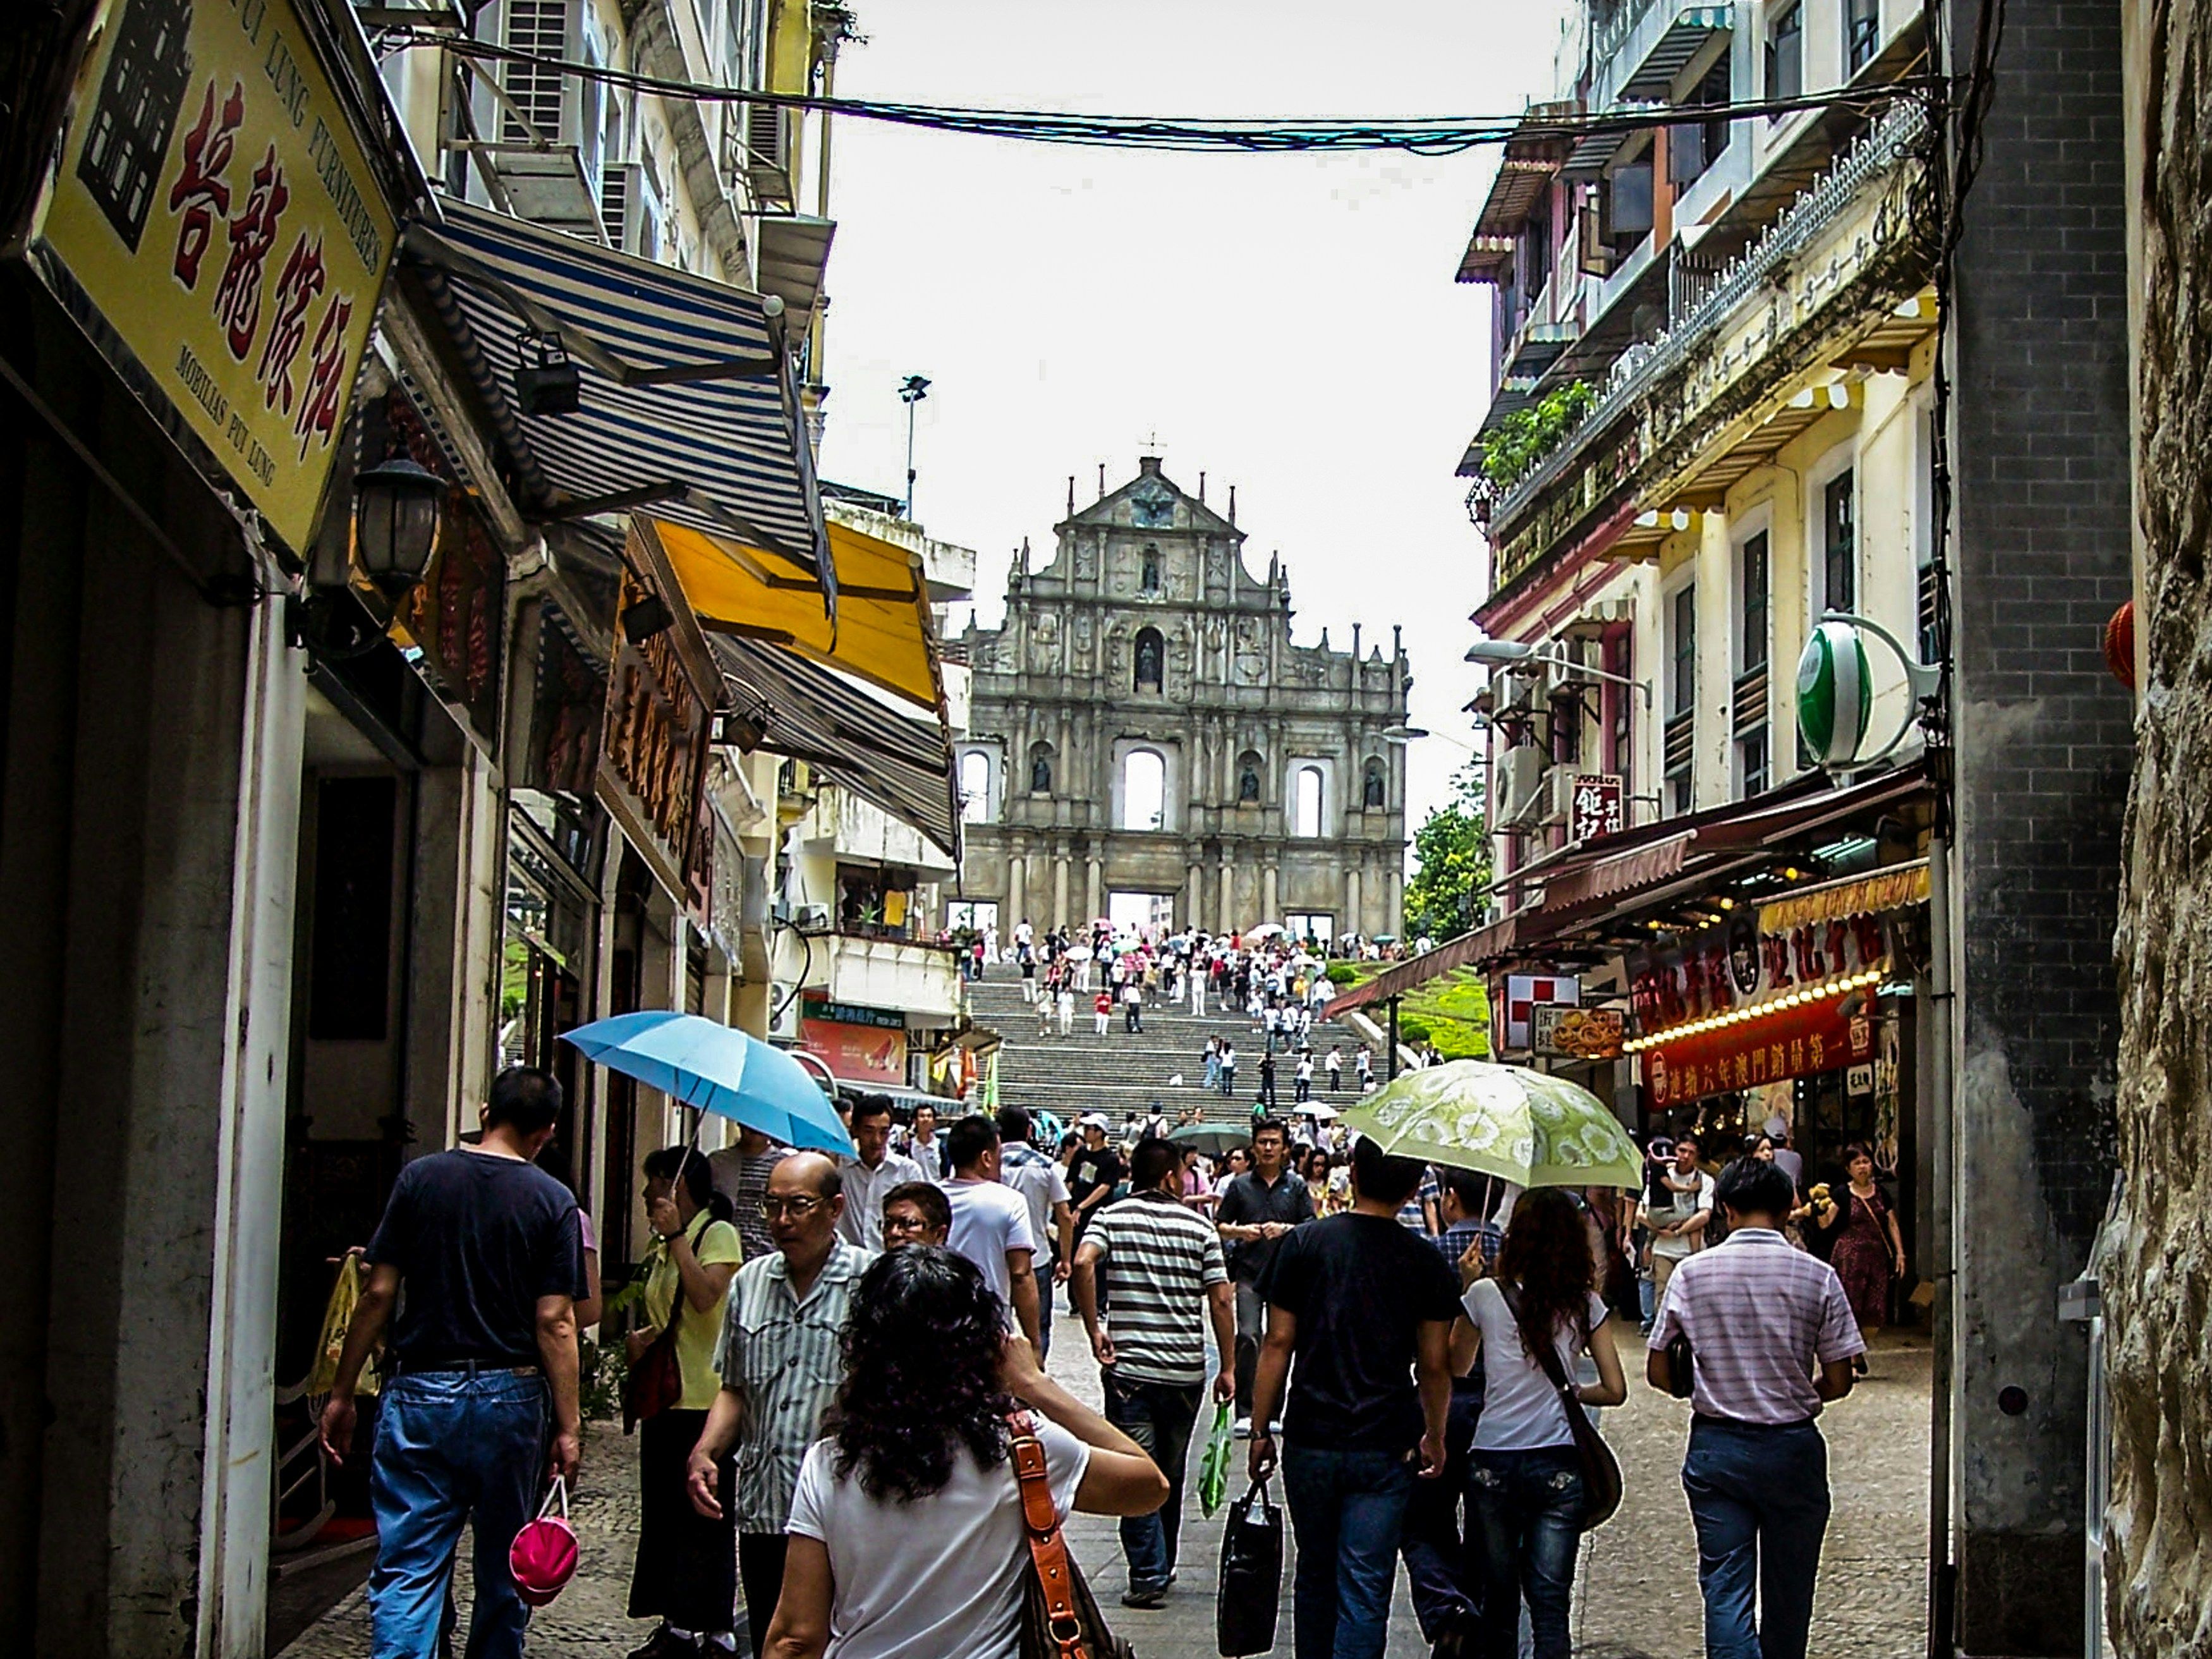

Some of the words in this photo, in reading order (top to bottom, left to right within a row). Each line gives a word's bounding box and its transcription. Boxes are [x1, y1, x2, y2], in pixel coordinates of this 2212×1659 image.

[231, 0, 267, 46] UI
[264, 29, 310, 128] LUNG
[308, 115, 382, 277] FURNITURES
[176, 345, 228, 426] MOBILIAS
[227, 413, 250, 454] PUI
[247, 441, 275, 487] LUNG
